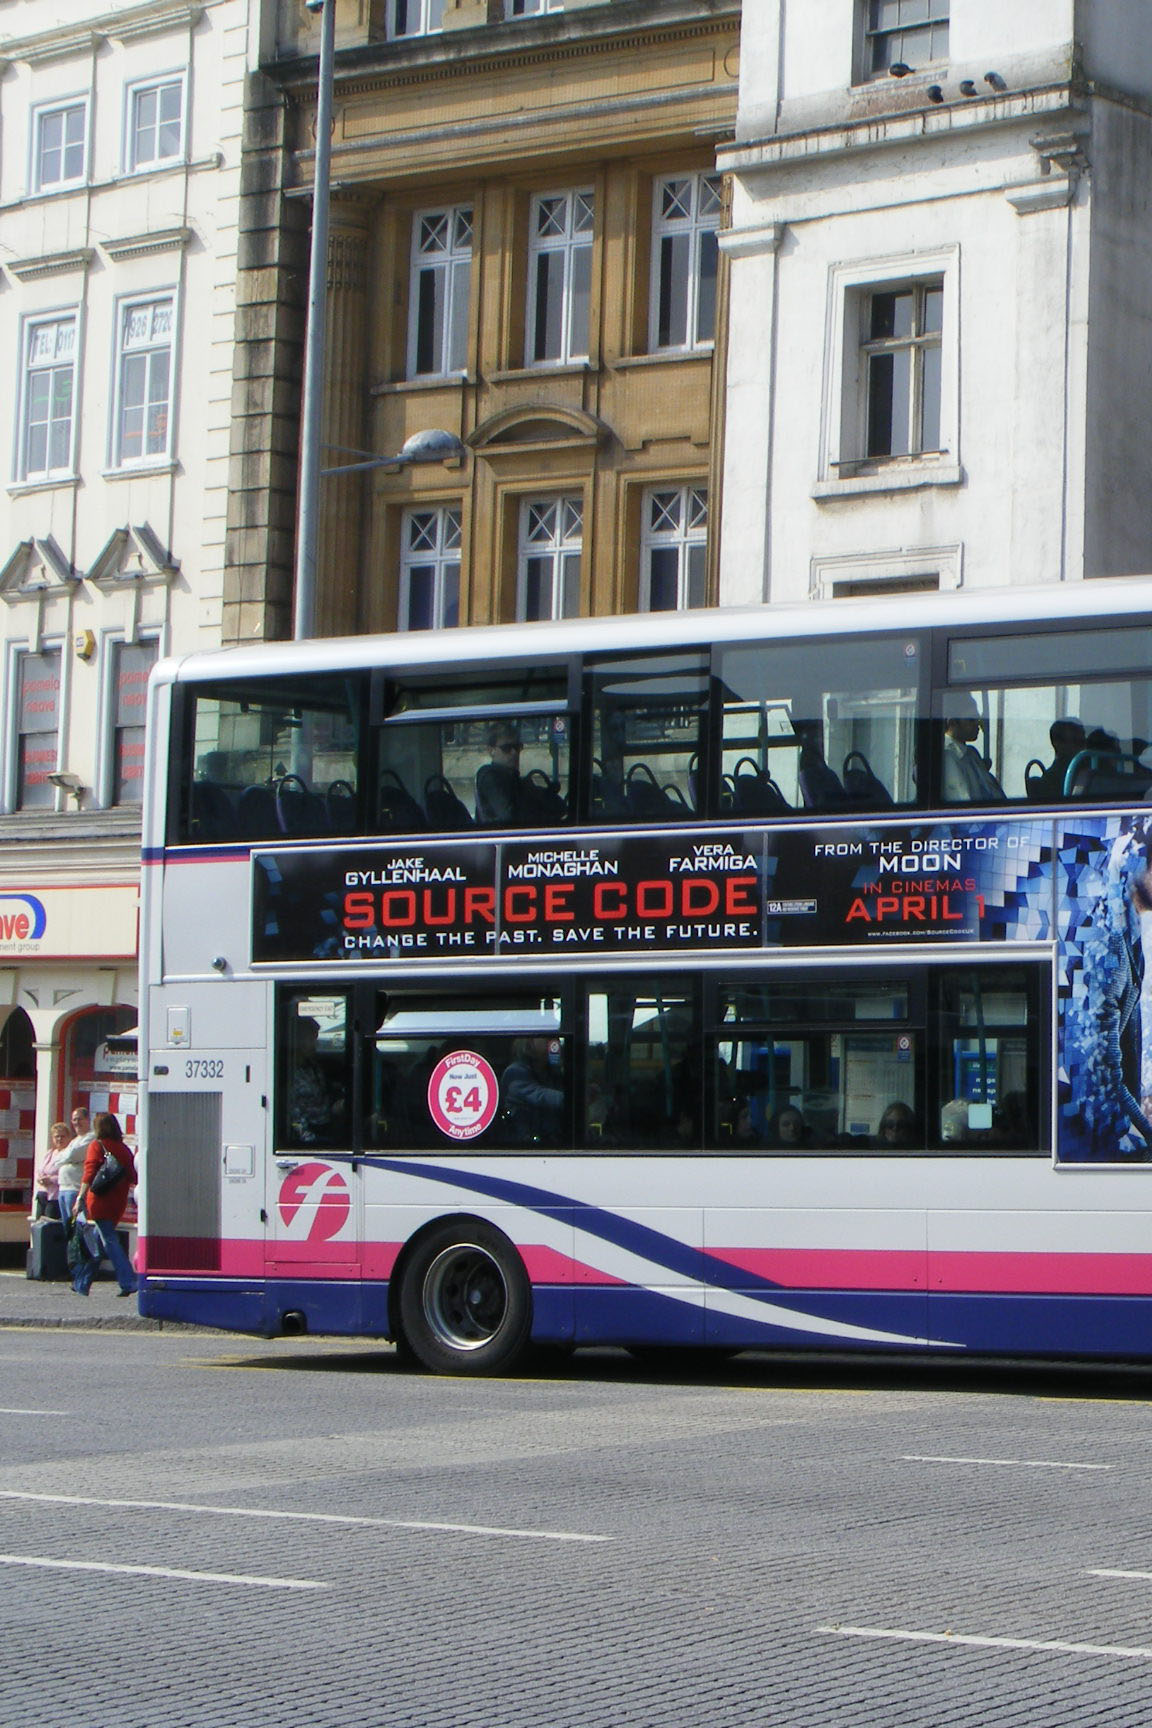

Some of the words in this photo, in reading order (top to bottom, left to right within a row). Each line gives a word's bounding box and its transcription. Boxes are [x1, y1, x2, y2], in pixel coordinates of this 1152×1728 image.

[693, 844, 734, 856] VERA
[814, 844, 862, 856] FROM
[870, 842, 902, 854] THE
[911, 837, 999, 853] DIRECTOR
[1007, 836, 1030, 849] OF
[387, 858, 424, 870] JAKE
[528, 850, 600, 863] MICHELLE
[669, 855, 757, 872] FARMIGA
[879, 853, 961, 873] MOON
[345, 867, 466, 886] GYLLENHAAL
[508, 861, 618, 878] MONAGHAN
[864, 881, 882, 894] IN
[892, 878, 976, 893] CINEMAS
[344, 884, 575, 928] SOURCE
[594, 877, 758, 920] CODE
[769, 902, 782, 913] 12A
[845, 896, 963, 923] APRIL
[976, 895, 985, 918] 1
[345, 933, 427, 948] CHANGE
[436, 932, 475, 945] THE
[486, 929, 542, 944] PAST.
[552, 928, 604, 942] SAVE
[614, 926, 655, 940] THE
[666, 923, 758, 938] FUTURE.
[185, 1060, 224, 1078] 37332
[445, 1086, 482, 1113] £4
[448, 1124, 482, 1137] Anytime
